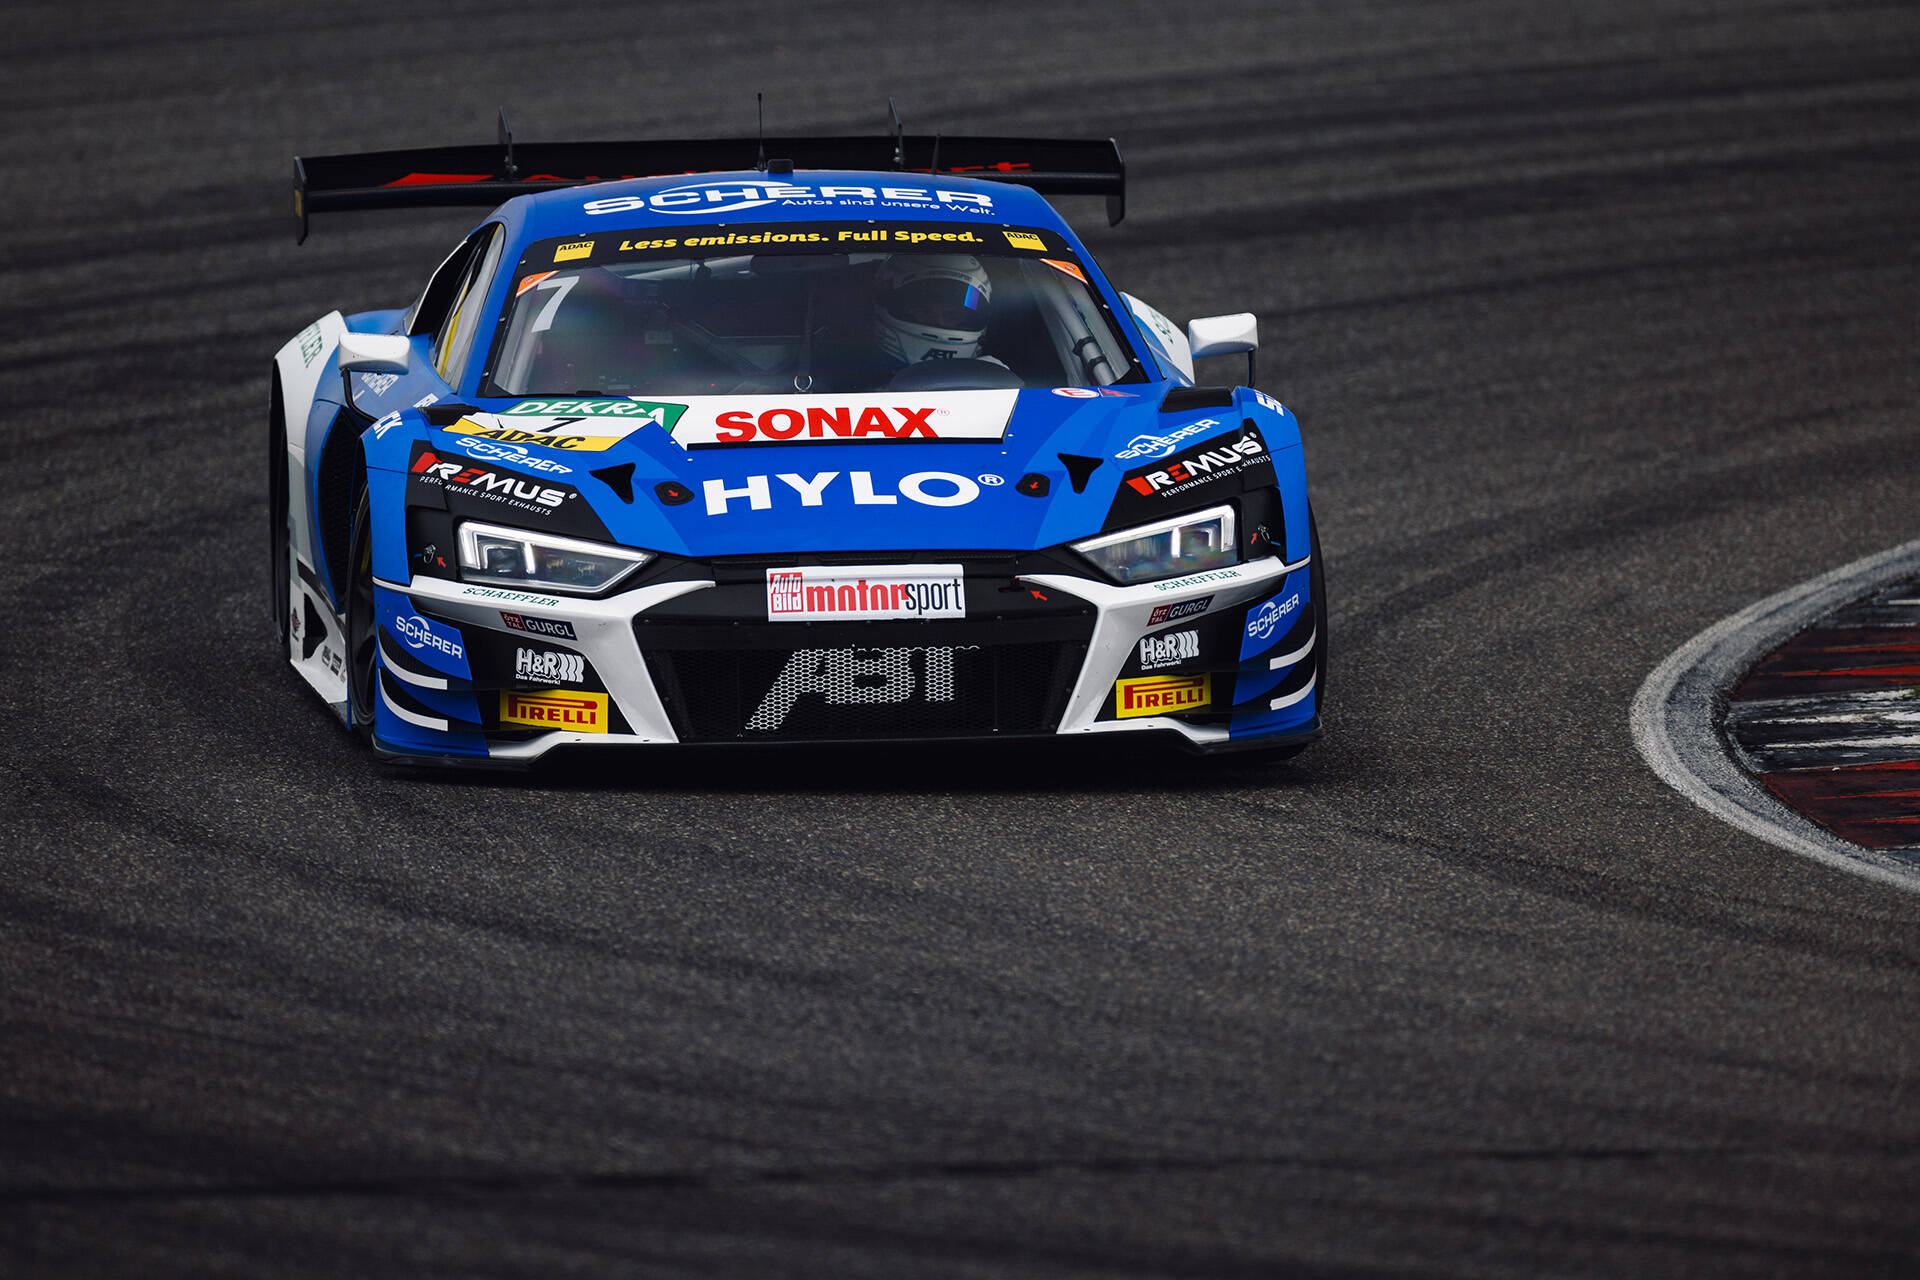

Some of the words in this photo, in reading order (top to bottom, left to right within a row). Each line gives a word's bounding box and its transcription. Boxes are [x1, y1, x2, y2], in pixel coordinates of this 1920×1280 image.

[583, 185, 993, 215] SCHERER
[782, 199, 833, 207] Autos
[840, 198, 874, 206] sind
[881, 201, 940, 209] unsere
[946, 204, 995, 216] Welt.
[559, 242, 592, 251] ADAC
[619, 240, 677, 251] Less
[683, 231, 829, 247] emissions.
[838, 230, 887, 241] Full
[894, 230, 984, 243] Speed.
[1006, 232, 1037, 241] ADAC
[531, 275, 580, 333] 7
[507, 401, 665, 427] DEKRA
[537, 417, 588, 433] 7
[473, 429, 586, 449] ADAC
[1115, 418, 1220, 460] SCHERER
[456, 437, 573, 475] SCHERER
[1161, 475, 1213, 498] PERFORMANCE
[1213, 467, 1235, 480] SPORT
[479, 491, 507, 504] SPORT
[508, 499, 552, 516] EXHAUSTS
[770, 574, 802, 594] Auto
[1153, 570, 1242, 592] SCHAEFFLER
[463, 587, 559, 607] SCHAEFFLER
[772, 593, 803, 612] Bild
[1169, 599, 1208, 618] GURGL
[525, 619, 574, 637] GURGL
[1247, 593, 1300, 638] SCHERER
[395, 616, 463, 659] SCHERER
[1140, 634, 1182, 665] H&R
[515, 647, 561, 679] H&R
[745, 646, 980, 730] ABT
[1123, 677, 1205, 710] PIRELLI
[507, 693, 599, 725] PIRELLI
